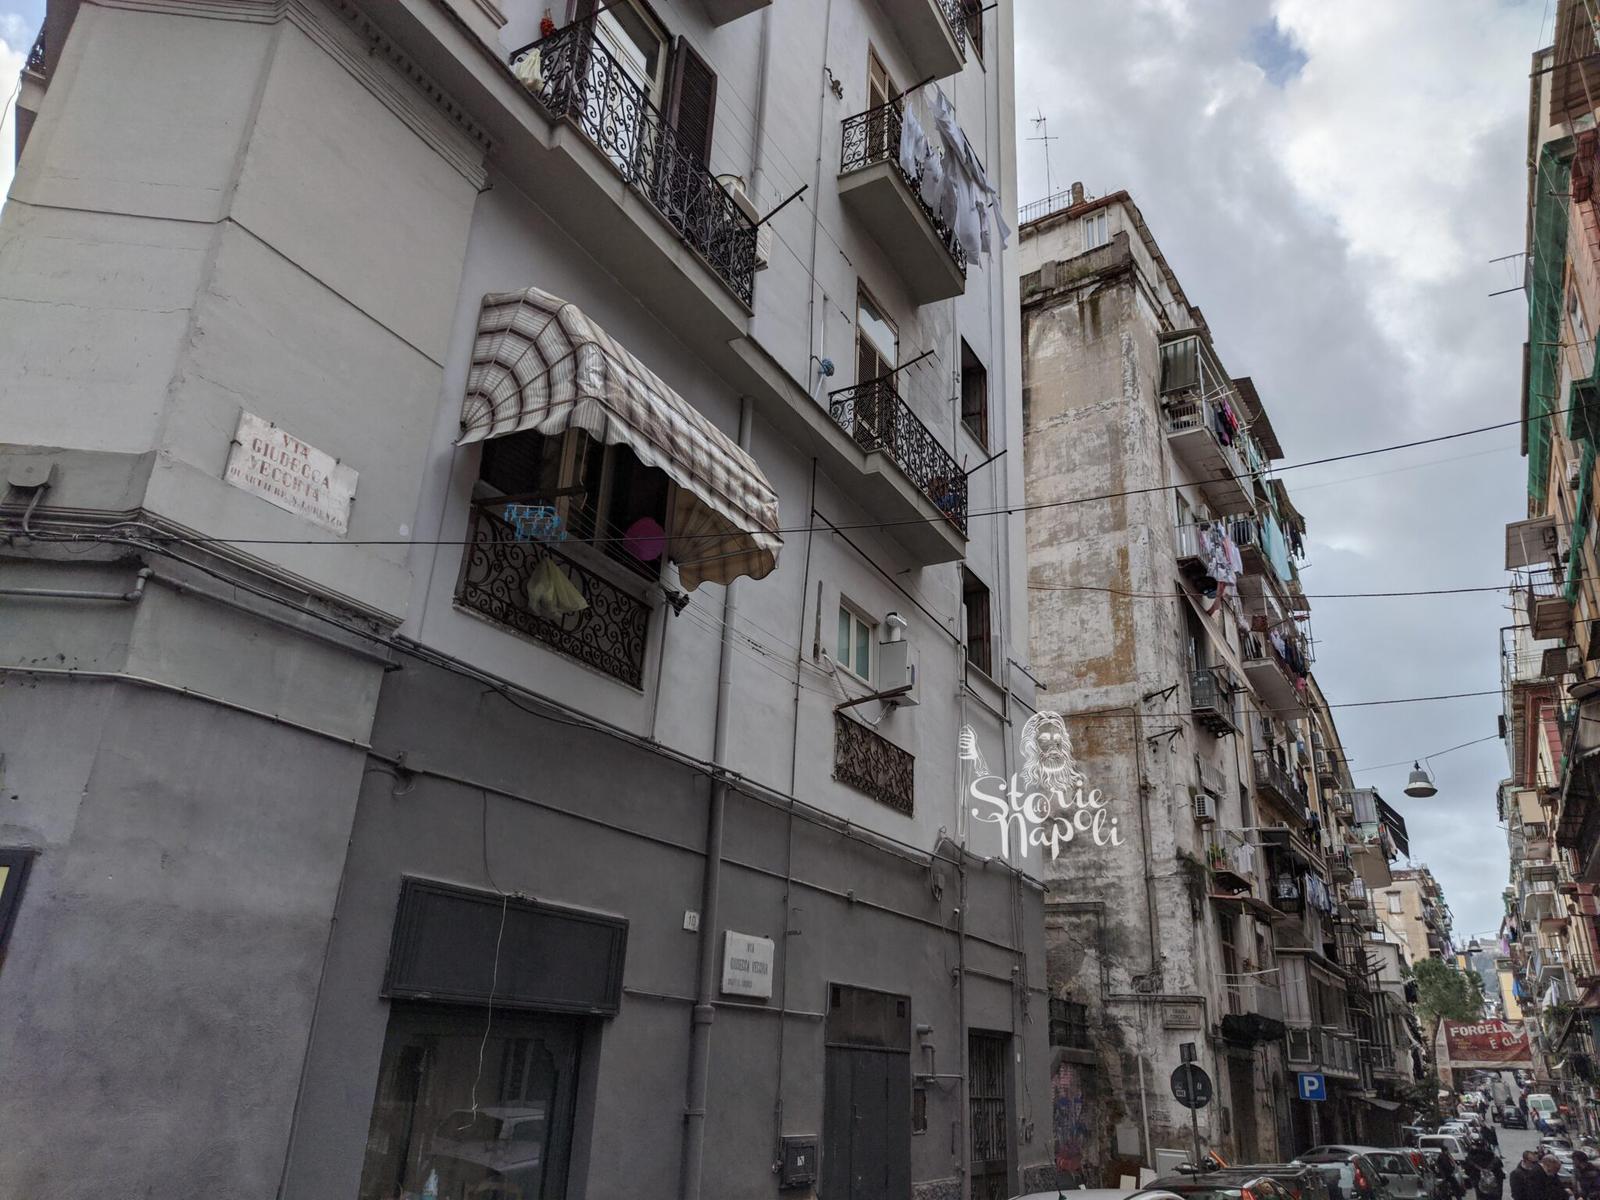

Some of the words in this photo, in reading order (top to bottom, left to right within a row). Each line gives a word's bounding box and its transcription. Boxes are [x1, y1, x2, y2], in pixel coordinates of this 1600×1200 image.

[282, 433, 311, 460] VIA
[249, 454, 320, 502] VECCHIA
[1450, 1024, 1511, 1037] FORCELL
[1303, 1076, 1319, 1097] P
